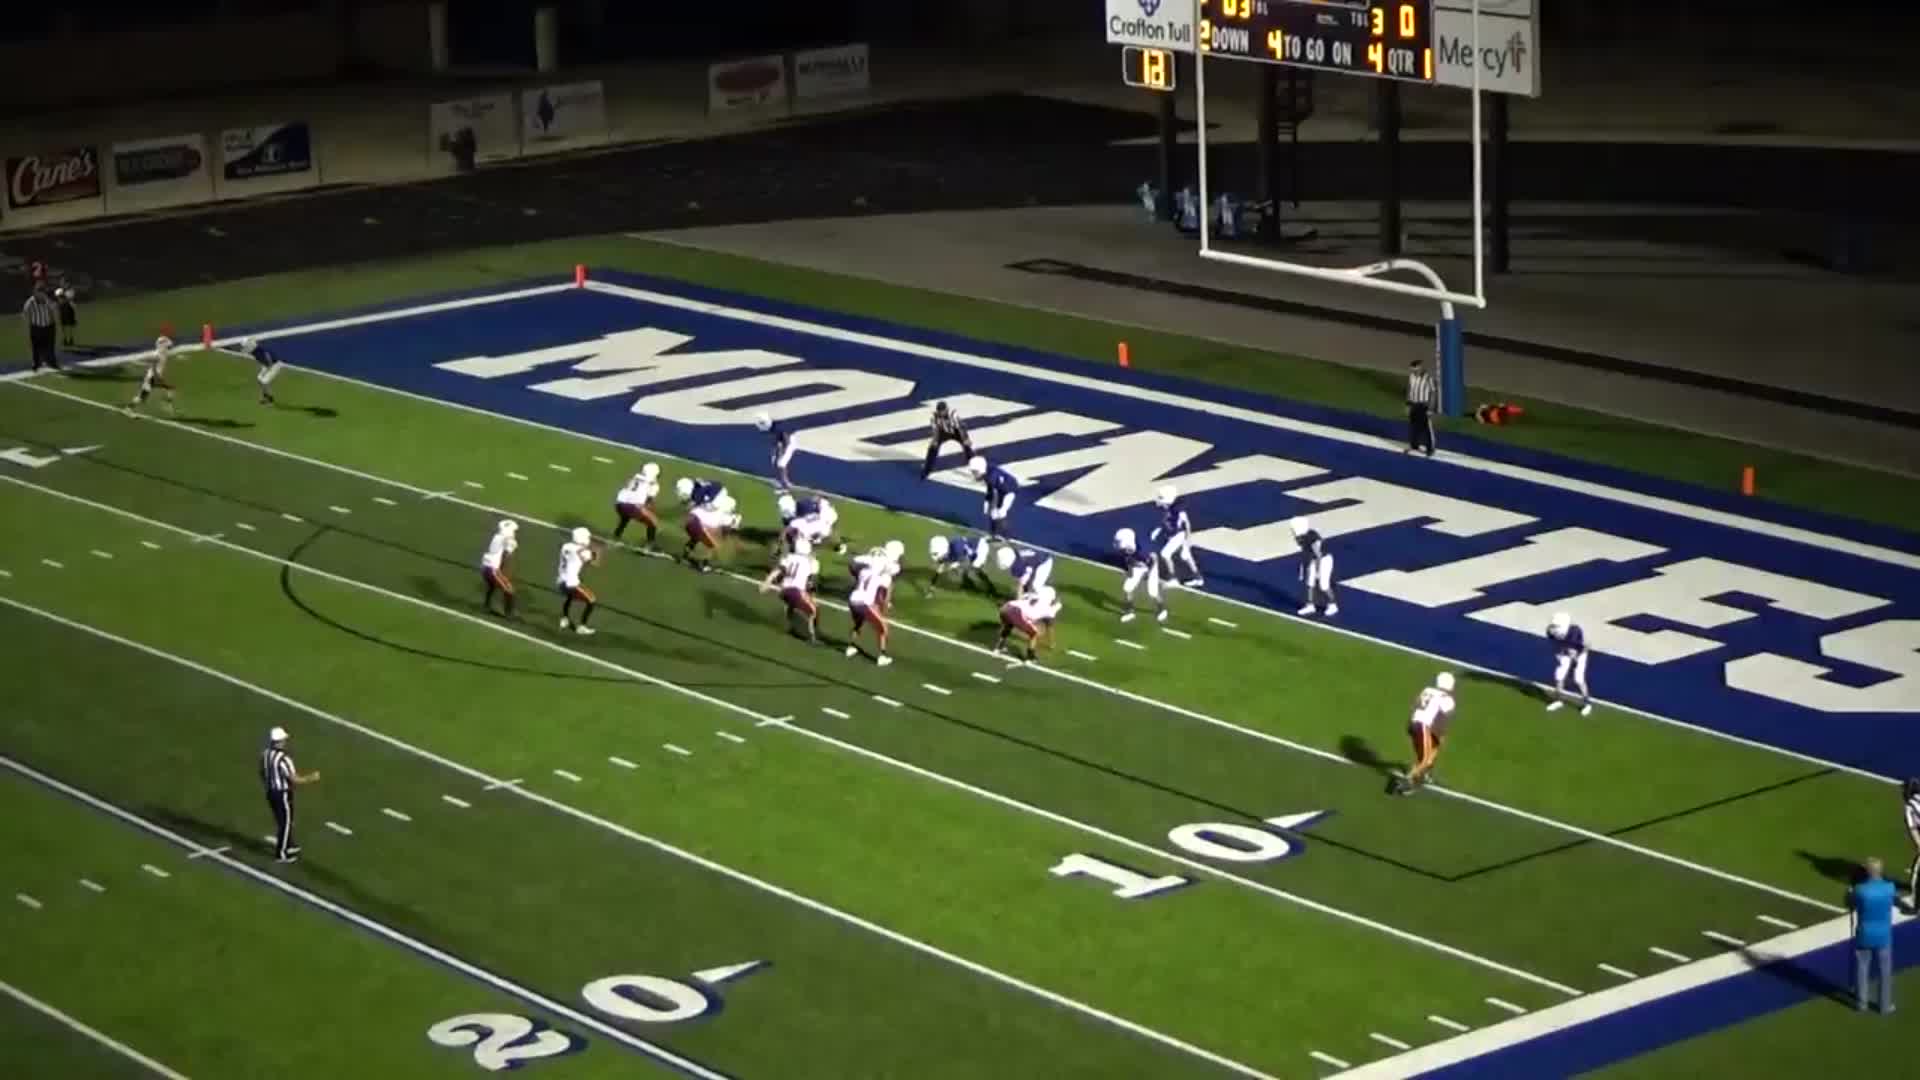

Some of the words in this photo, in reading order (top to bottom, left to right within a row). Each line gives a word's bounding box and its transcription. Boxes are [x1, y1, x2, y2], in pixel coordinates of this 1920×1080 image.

[1110, 15, 1165, 40] Crafton
[1168, 21, 1190, 43] Tull
[1400, 5, 1415, 36] 0
[1211, 26, 1249, 52] DOWN
[1267, 29, 1283, 60] 4
[1284, 34, 1301, 59] TO
[1306, 37, 1325, 62] GO
[1332, 41, 1352, 65] ON
[1368, 42, 1383, 73] 4
[1387, 48, 1414, 74] QTR
[1424, 48, 1431, 79] 1
[13, 144, 95, 204] Cane's
[431, 327, 1920, 713] MOUNTIES
